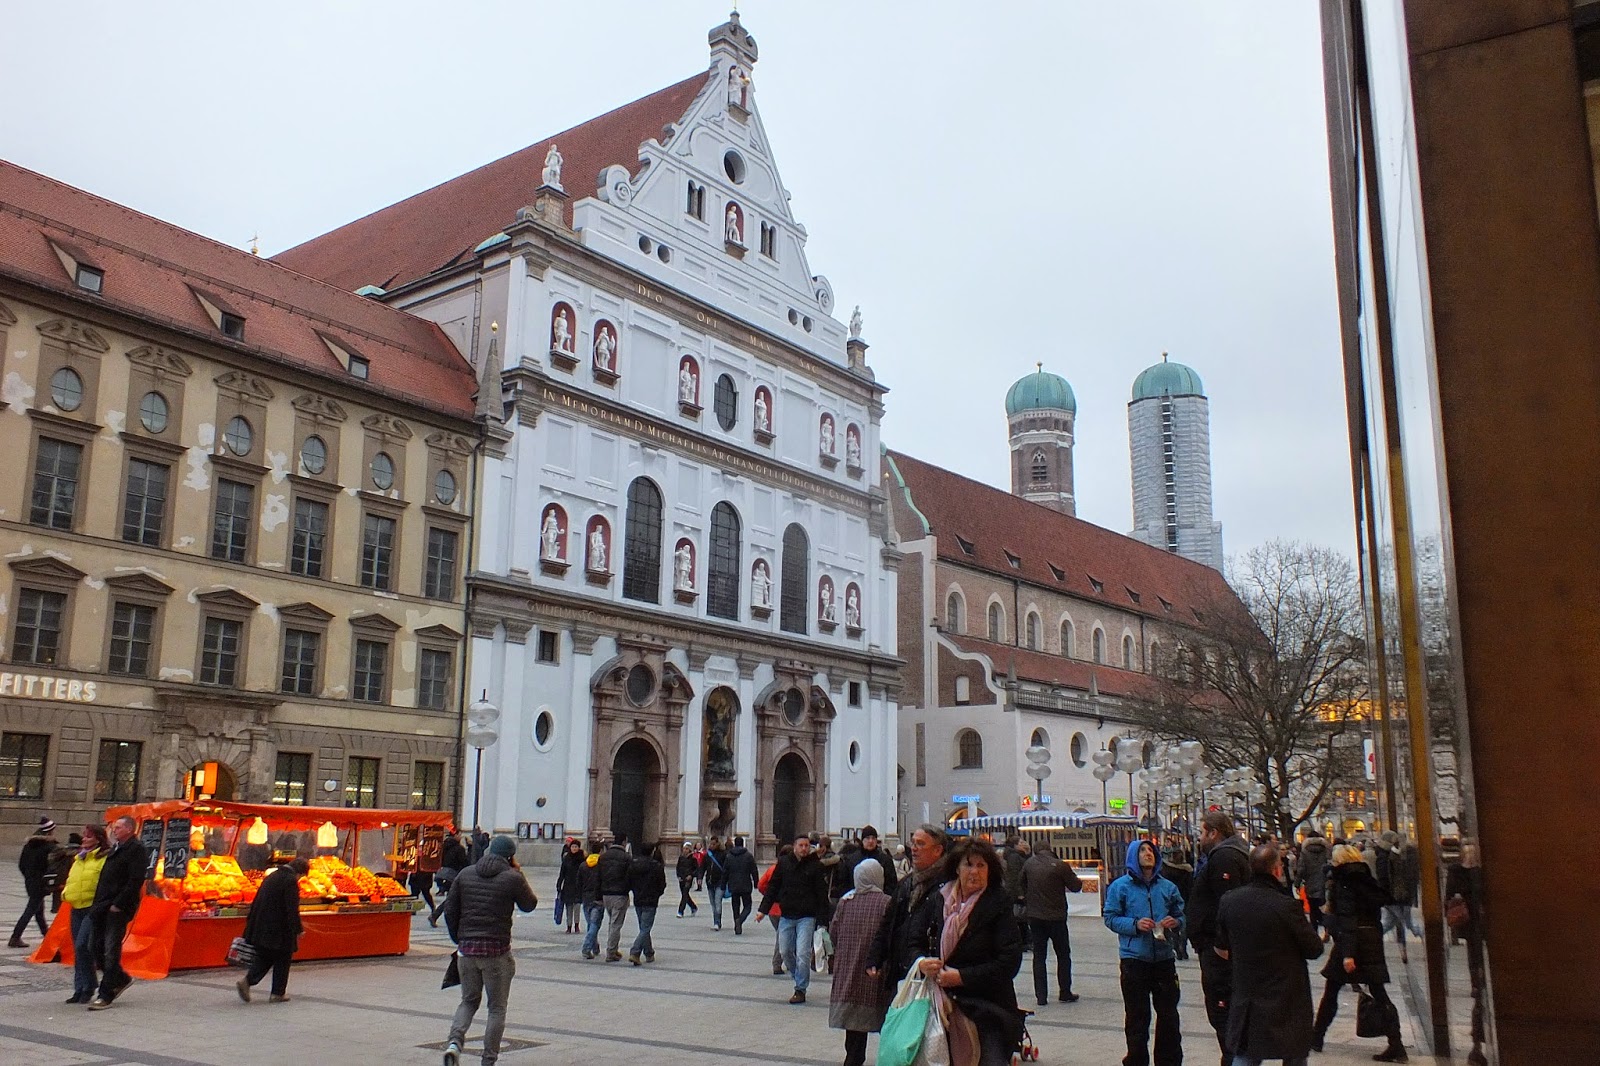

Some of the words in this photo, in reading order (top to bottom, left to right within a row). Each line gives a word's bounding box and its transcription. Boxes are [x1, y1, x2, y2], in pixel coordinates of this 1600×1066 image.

[638, 284, 662, 303] DEO
[696, 312, 718, 328] OPT
[749, 335, 772, 353] MAX
[543, 388, 556, 403] IN
[561, 394, 632, 428] MEMORIAM
[648, 425, 707, 454] MICHAELIS
[0, 672, 97, 702] FITTERS
